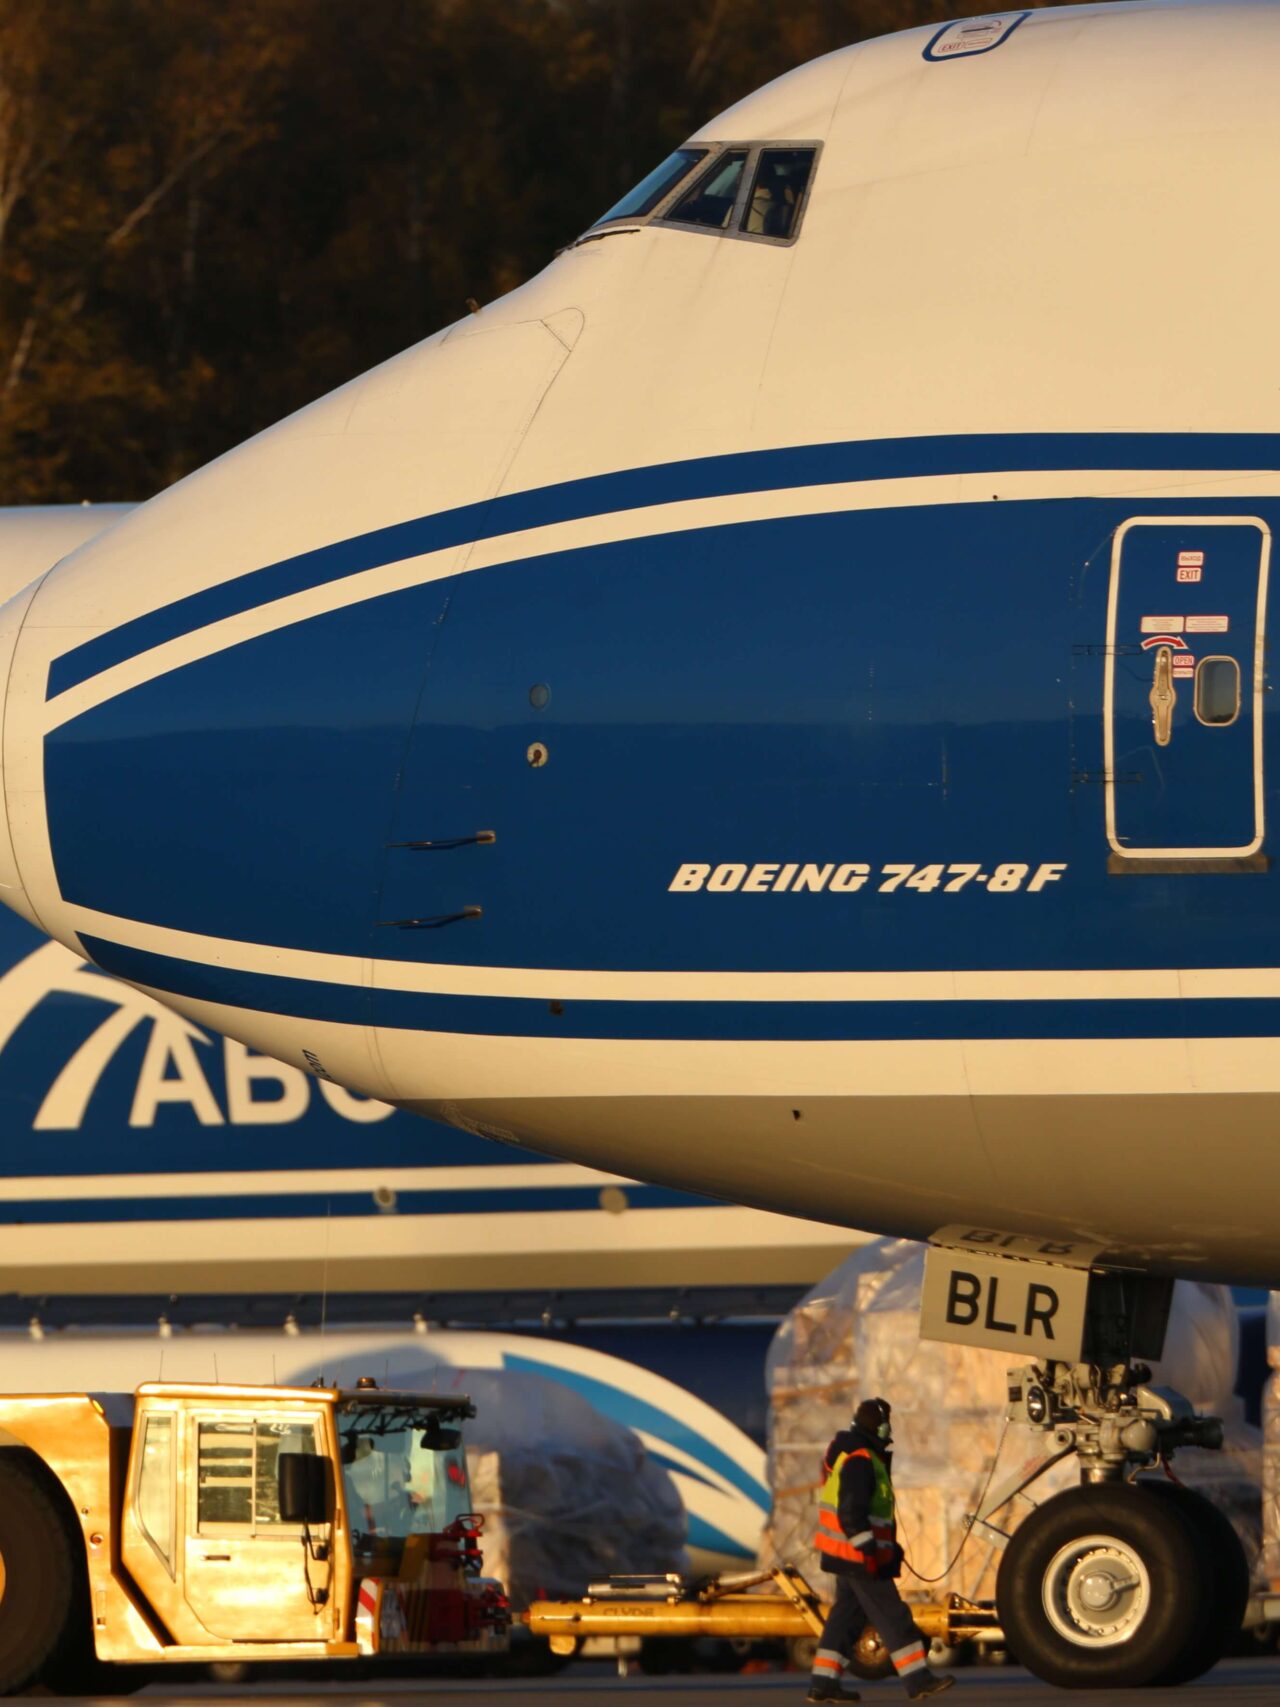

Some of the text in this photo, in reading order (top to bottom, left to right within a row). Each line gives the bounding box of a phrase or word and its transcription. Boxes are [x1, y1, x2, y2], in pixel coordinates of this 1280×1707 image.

[1179, 569, 1199, 580] EXIT
[1175, 656, 1193, 665] OPEN
[668, 863, 870, 893] BOEING
[946, 1270, 1060, 1340] BLR
